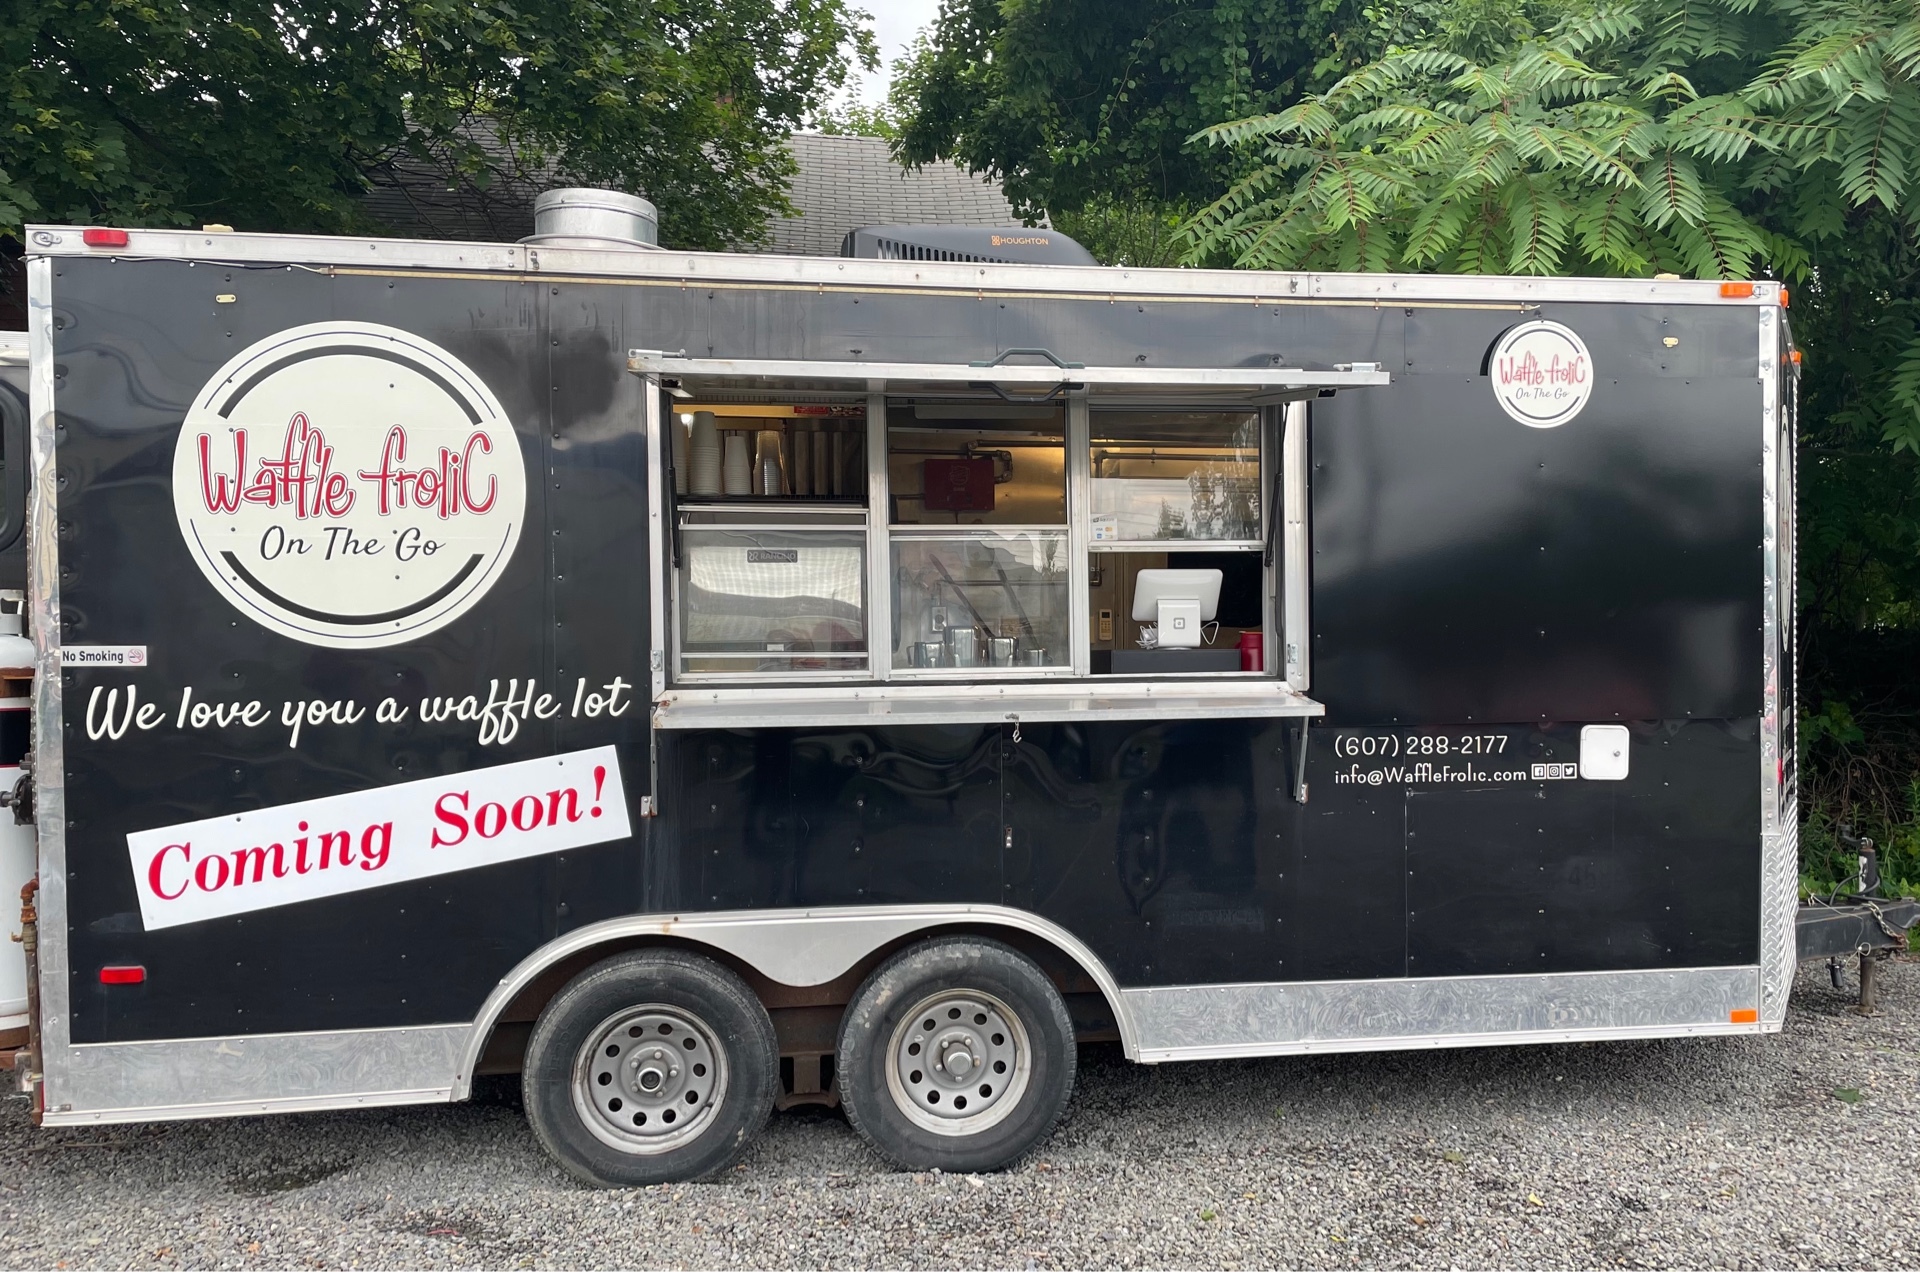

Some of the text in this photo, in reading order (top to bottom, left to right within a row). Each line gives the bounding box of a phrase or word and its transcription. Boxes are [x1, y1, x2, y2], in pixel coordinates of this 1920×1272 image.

[1000, 237, 1049, 245] HOUGHTON
[1499, 350, 1545, 386] Waffle
[1516, 387, 1568, 399] On The Go
[197, 411, 356, 520] Waffle
[260, 525, 446, 561] On The Go
[62, 650, 124, 664] No Smoking
[86, 676, 632, 748] We love you a waffle lot
[1334, 734, 1508, 757] (607) 288-2177
[1335, 763, 1526, 785] info@WaffleFrolic.com
[148, 765, 606, 900] Coming Soon!
